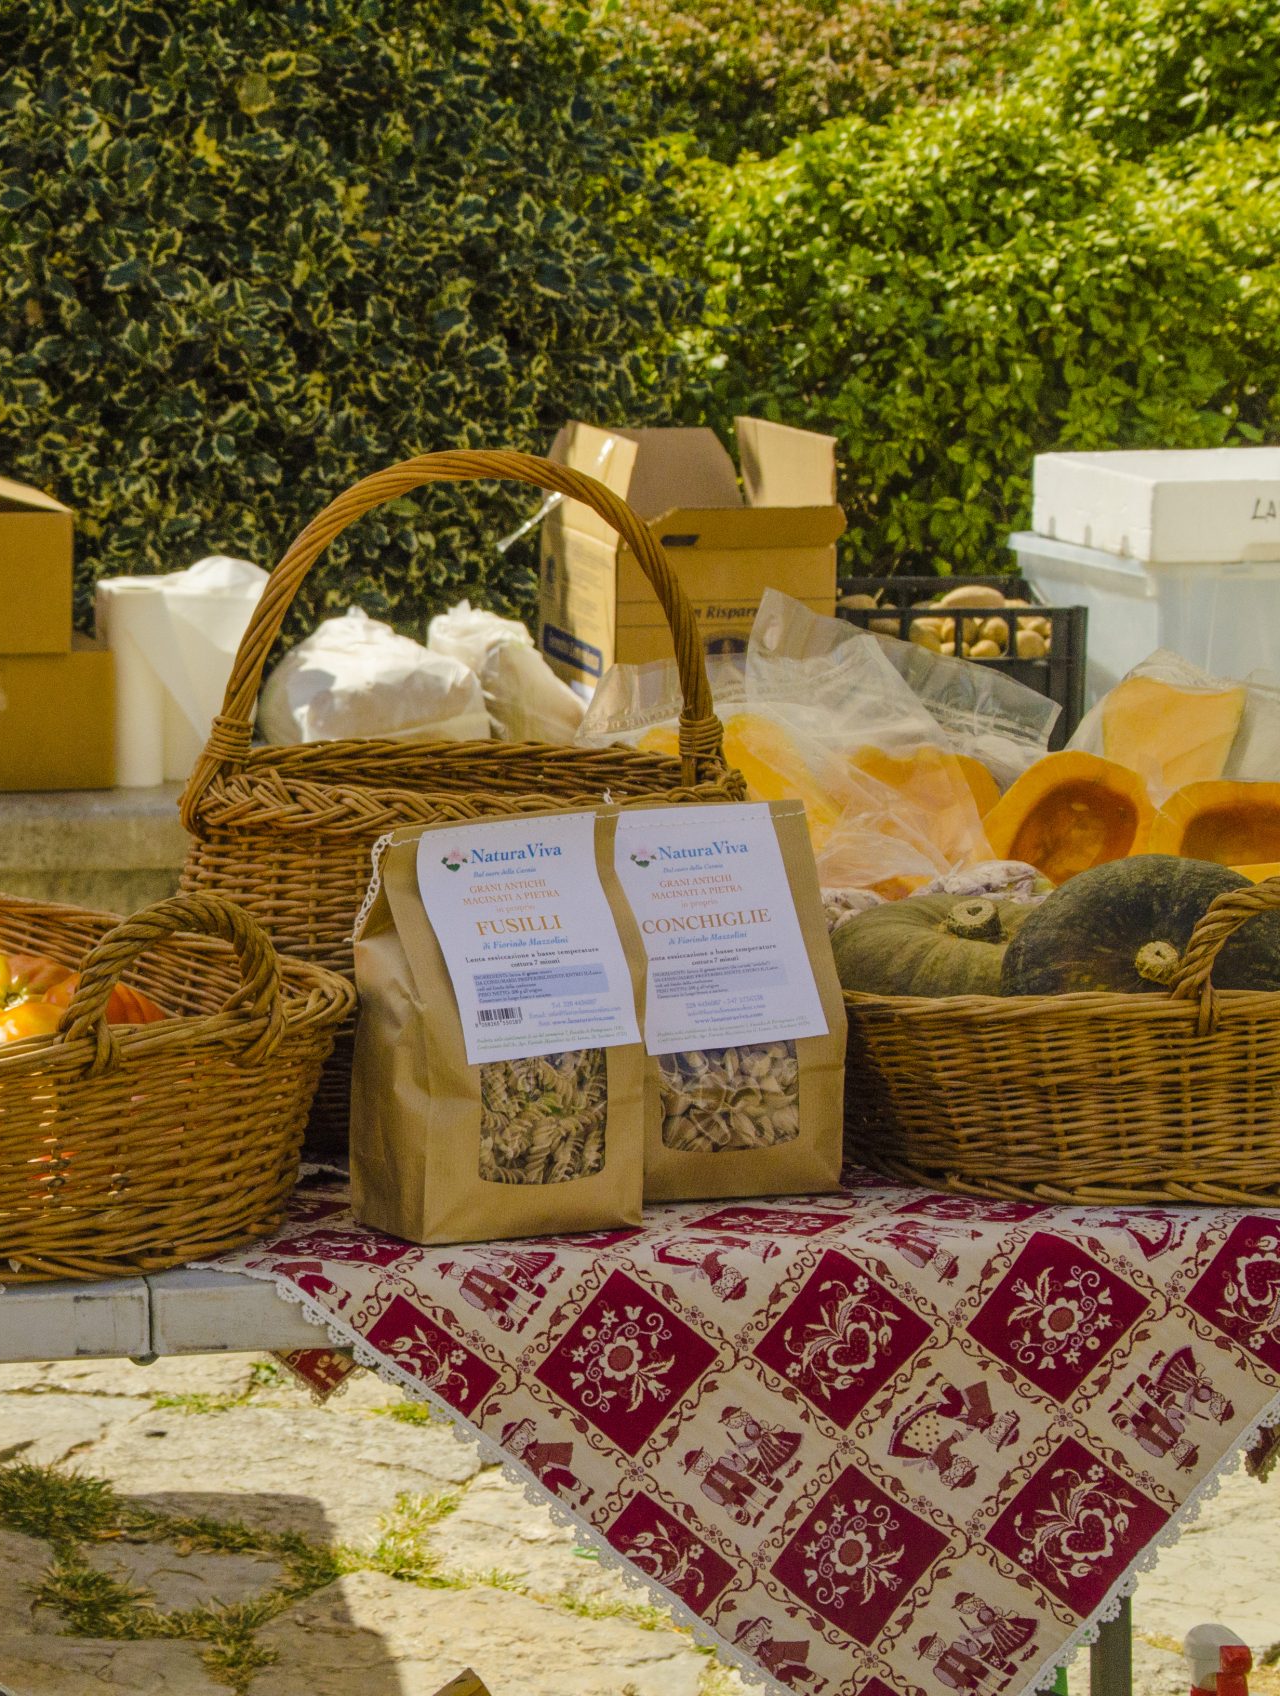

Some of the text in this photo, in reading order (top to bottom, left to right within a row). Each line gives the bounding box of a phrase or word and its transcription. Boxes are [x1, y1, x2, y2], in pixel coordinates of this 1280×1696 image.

[469, 879, 547, 894] GRANI ANTICHI
[659, 874, 733, 889] GRANI ANTICHI
[462, 889, 560, 906] MACINATI A PIETRA
[650, 884, 743, 901] MACINATI A PIETRA
[476, 914, 563, 936] FUSILLI
[642, 908, 772, 935] CONCHIGLIE
[482, 942, 491, 951] di
[493, 939, 527, 950] Fiorindo
[465, 956, 486, 964] Lenta
[510, 960, 533, 968] cottura
